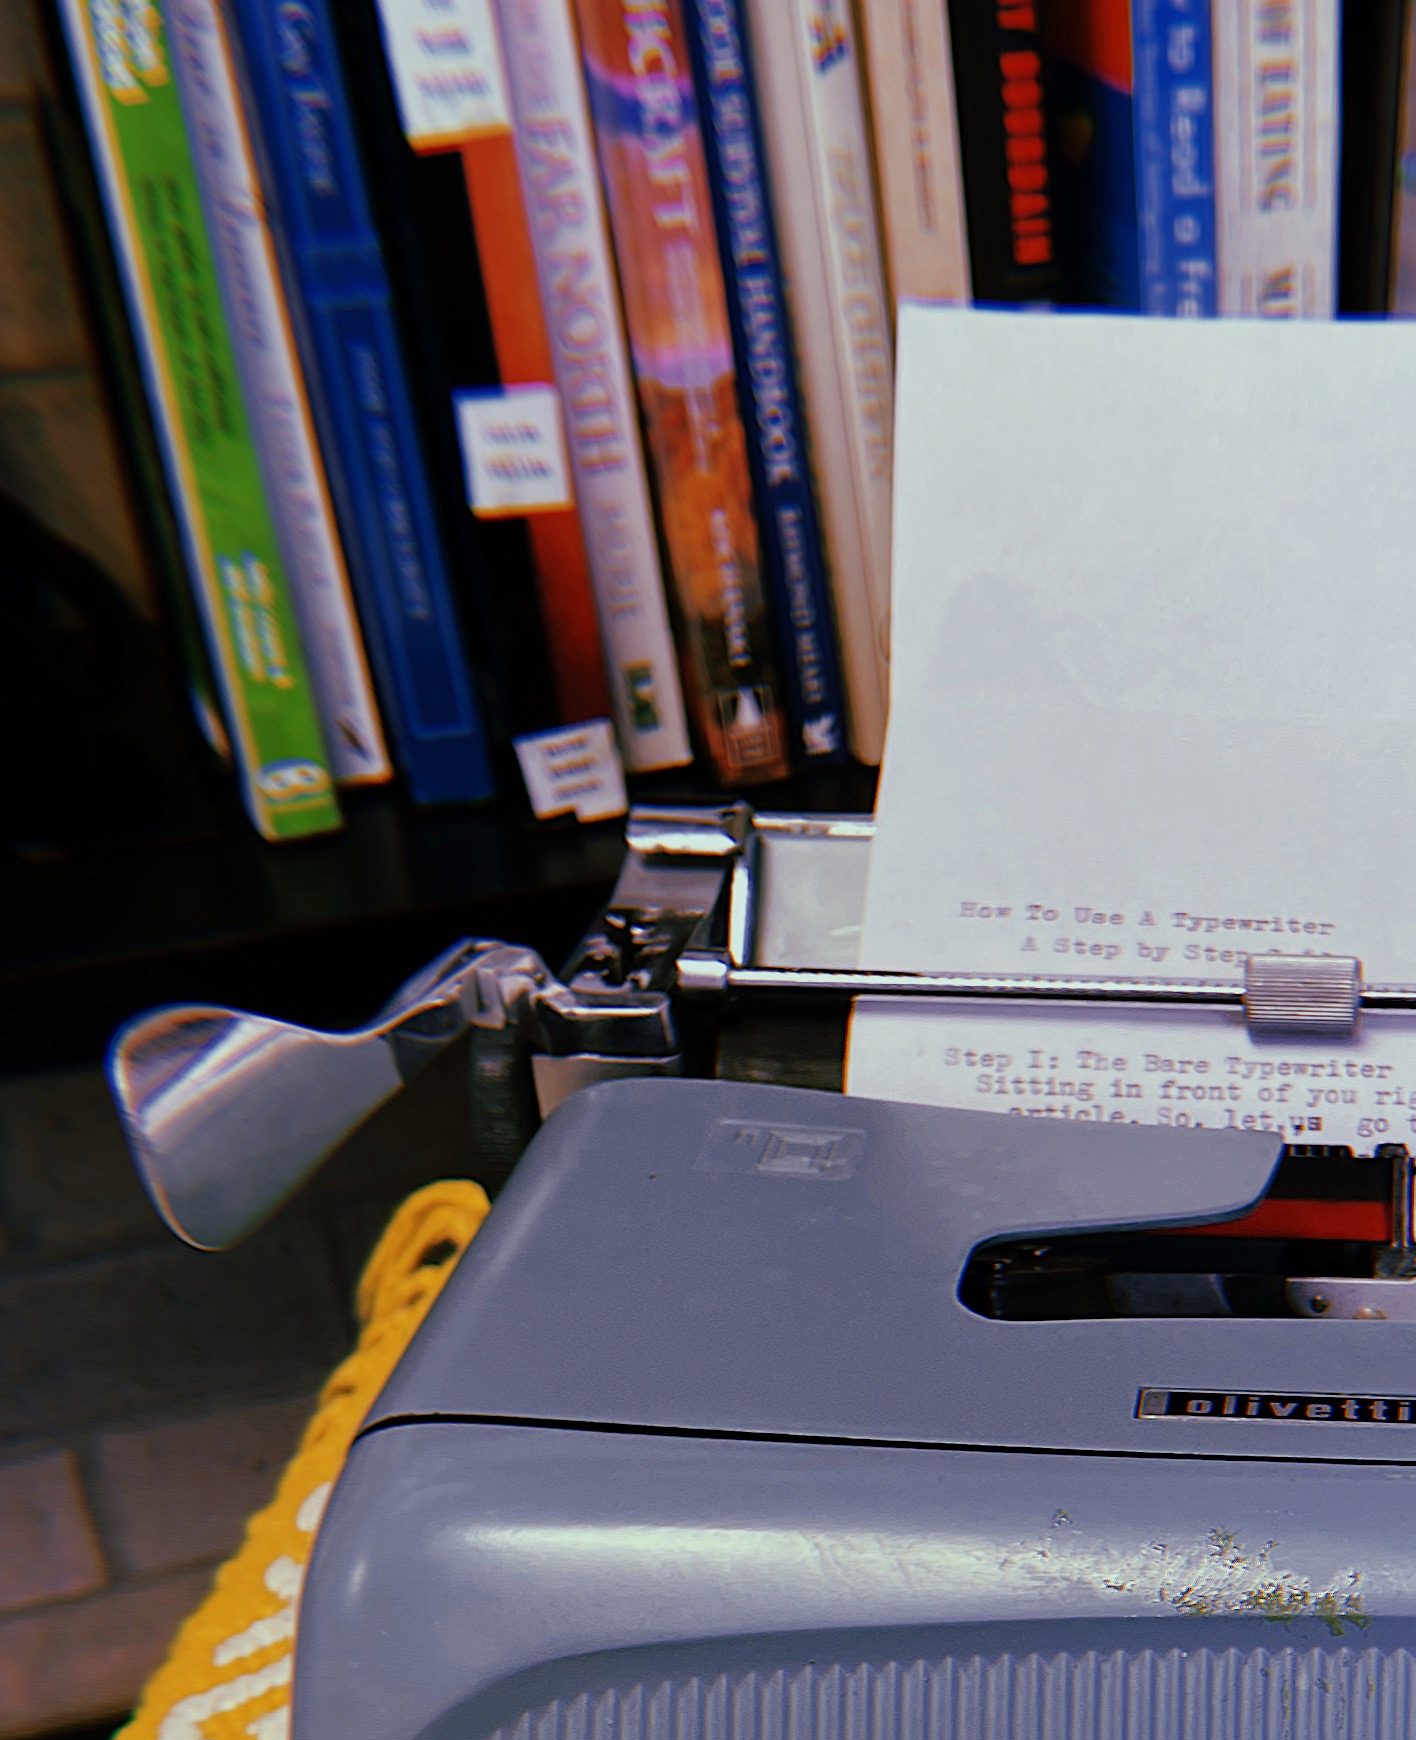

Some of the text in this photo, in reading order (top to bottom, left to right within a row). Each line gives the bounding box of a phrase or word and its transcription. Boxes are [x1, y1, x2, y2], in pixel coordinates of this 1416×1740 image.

[959, 901, 1336, 935] How To Use A Typewriter
[1019, 936, 1040, 952] A
[1053, 937, 1122, 960] Step
[1137, 941, 1170, 962] by
[944, 1047, 1014, 1073] Step
[1076, 1050, 1128, 1072] The
[1143, 1053, 1211, 1074] Bare
[1225, 1056, 1395, 1080] Typewriter
[974, 1073, 1097, 1102] Sitting
[1109, 1077, 1144, 1099] in
[1159, 1080, 1243, 1101] front
[1257, 1083, 1295, 1103] of
[1306, 1087, 1358, 1108] you
[1357, 1116, 1391, 1138] go
[1185, 1395, 1413, 1421] olivetti
